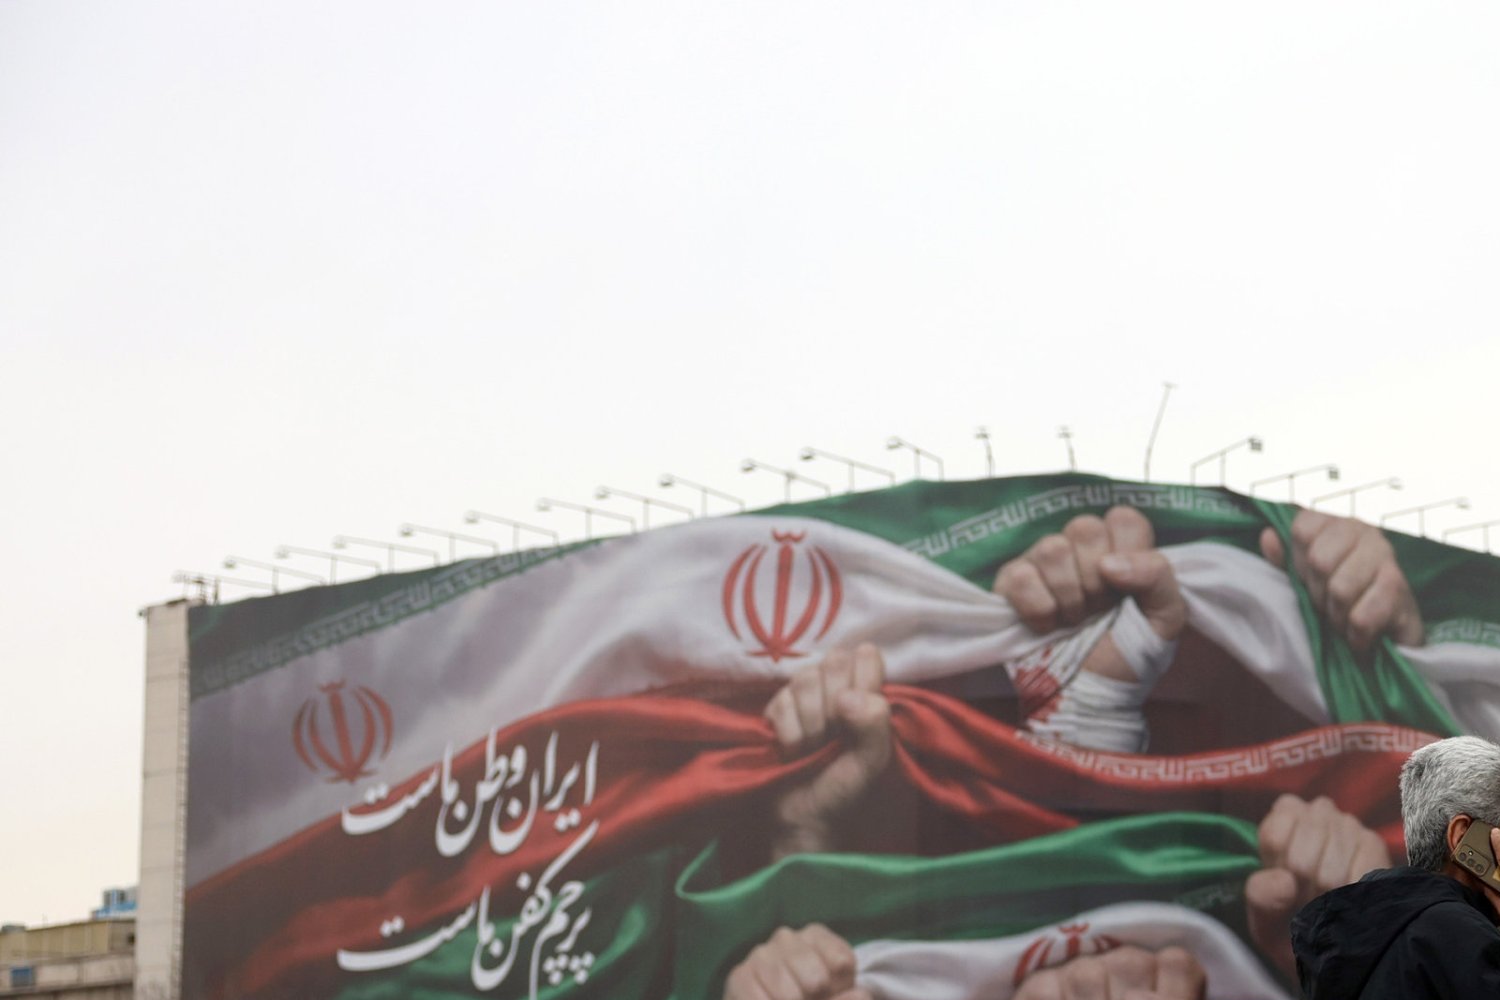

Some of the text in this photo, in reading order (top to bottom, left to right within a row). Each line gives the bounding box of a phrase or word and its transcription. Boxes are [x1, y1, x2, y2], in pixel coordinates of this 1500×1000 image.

[341, 726, 600, 857] ایران وطن ماست
[336, 885, 494, 972] ماست
[471, 820, 600, 991] کفن
